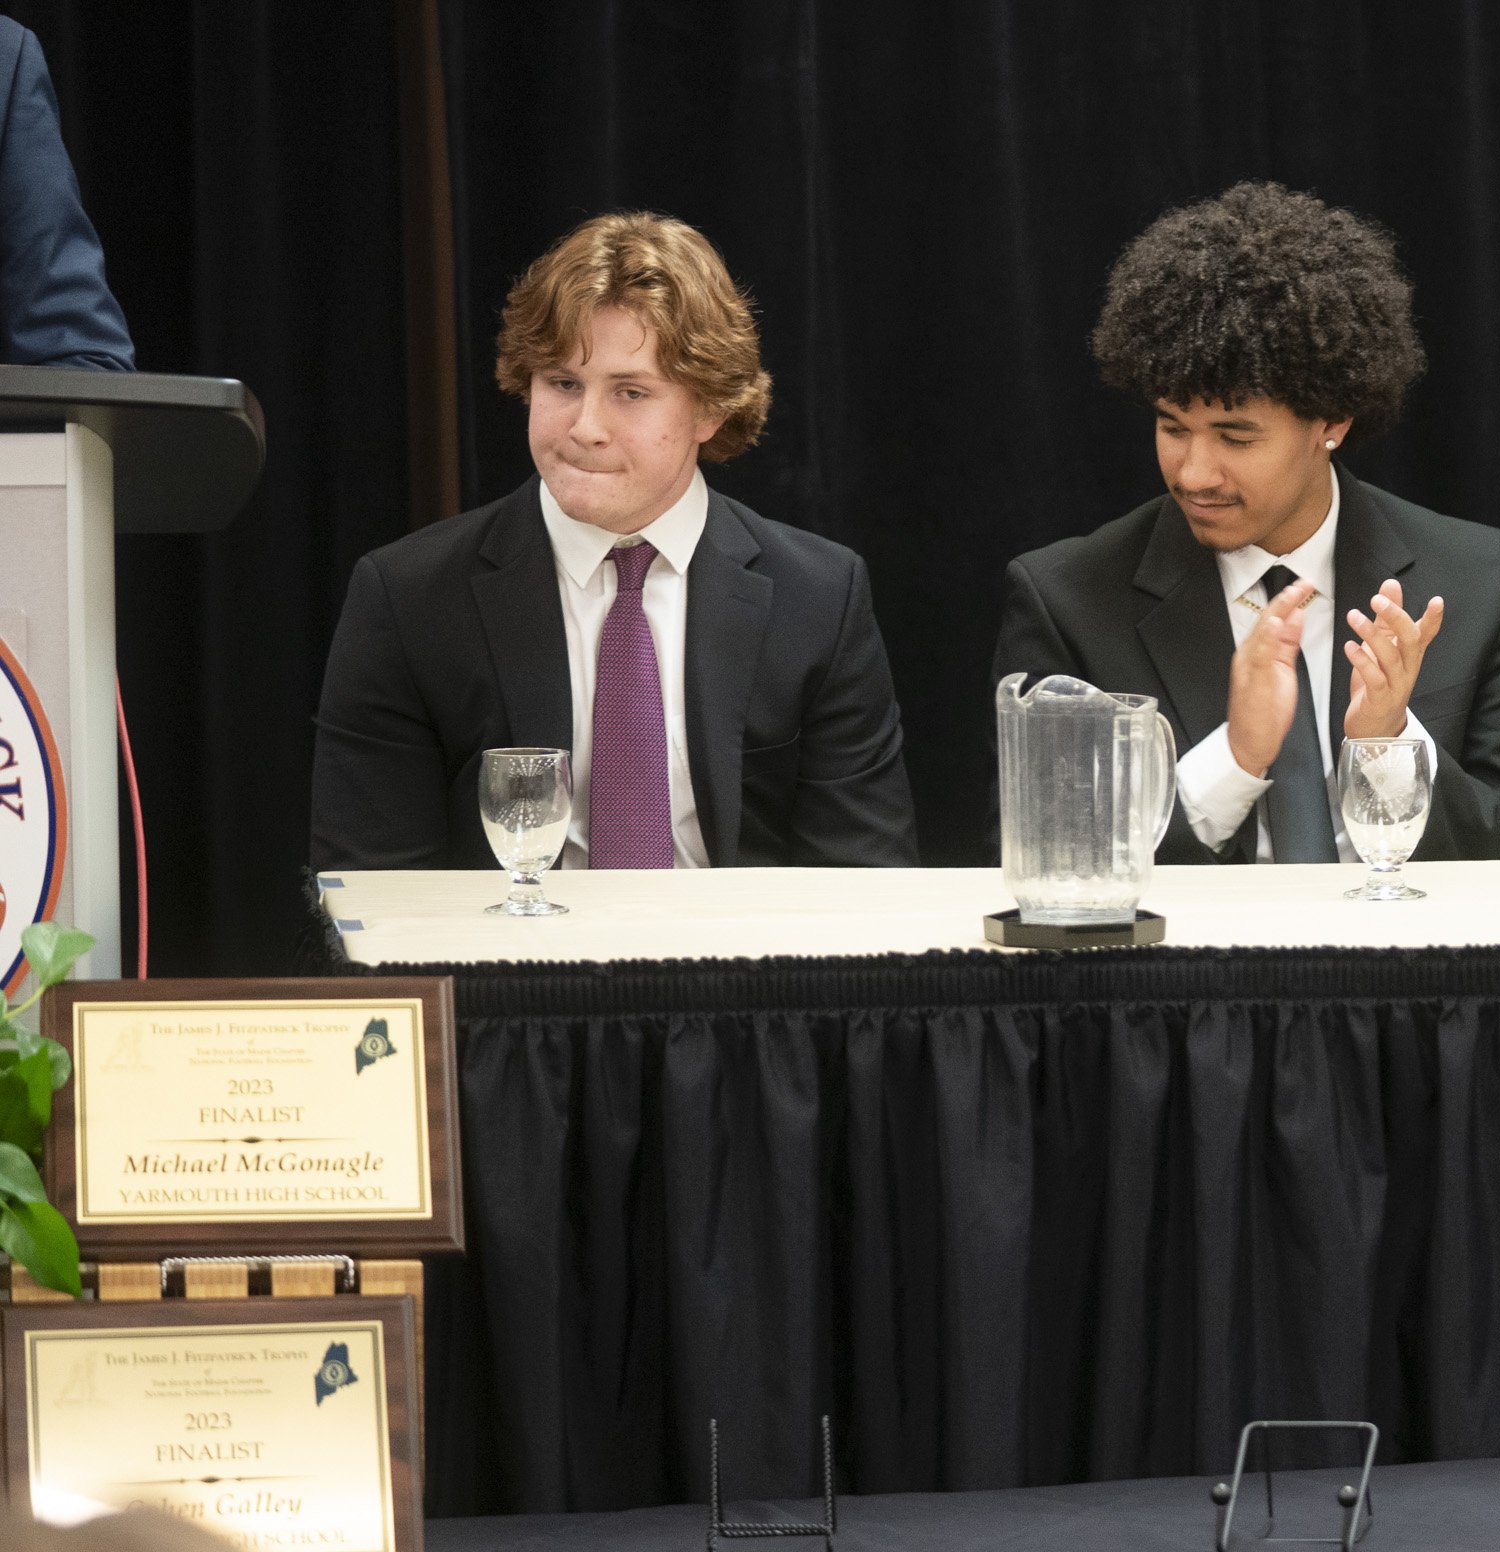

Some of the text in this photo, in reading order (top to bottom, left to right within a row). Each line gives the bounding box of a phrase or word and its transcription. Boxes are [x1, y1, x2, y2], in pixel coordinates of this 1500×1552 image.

[227, 1079, 274, 1096] 2023
[199, 1106, 305, 1124] FINALIST
[123, 1151, 385, 1178] Michael McGonagle
[119, 1185, 390, 1204] YARMOUTH HIGH SCHOOL
[185, 1412, 232, 1431] 2023
[156, 1441, 264, 1462] FINALIST
[216, 1492, 303, 1520] Galley
[264, 1529, 346, 1546] SCHOOL
